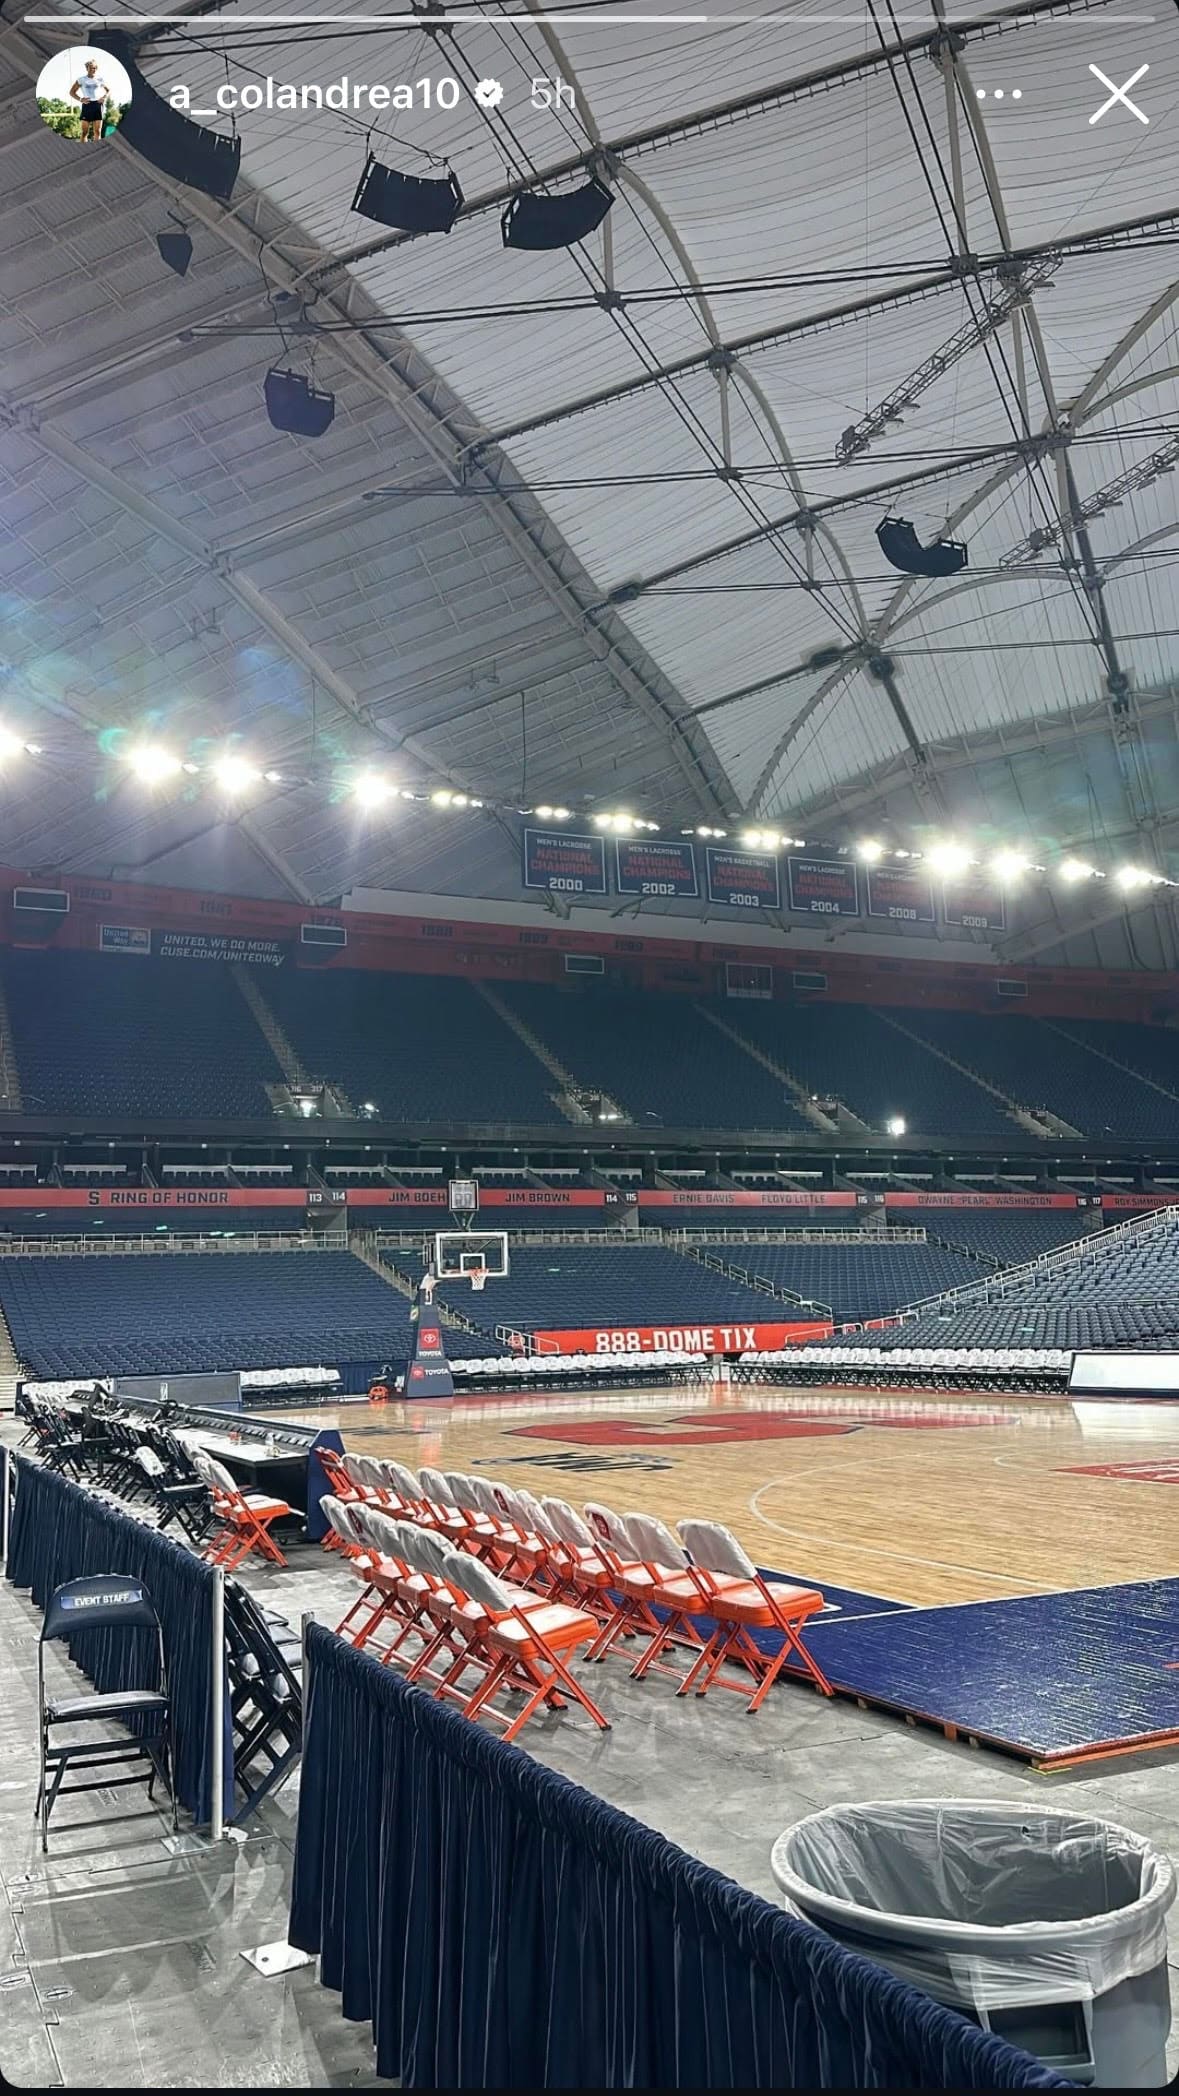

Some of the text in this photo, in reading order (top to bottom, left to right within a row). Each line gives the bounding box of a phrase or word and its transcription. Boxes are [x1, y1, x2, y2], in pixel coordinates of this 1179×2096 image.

[549, 877, 583, 892] 2000
[642, 883, 676, 895] 2002
[729, 893, 760, 907] 2003
[811, 900, 840, 913] 2004
[962, 915, 988, 928] 2009
[210, 939, 227, 948] WE
[229, 940, 245, 950] DO
[160, 946, 285, 963] CUSE.COM/UNITEDWAY
[110, 1192, 147, 1204] RING
[152, 1192, 171, 1204] OF
[176, 1192, 228, 1204] HONOR
[309, 1193, 322, 1203] 113
[332, 1191, 346, 1201] 114
[388, 1192, 448, 1203] JIM BOEH
[505, 1192, 570, 1203] JIM BROWN
[606, 1194, 618, 1203] 114
[626, 1193, 637, 1201] 115
[673, 1193, 735, 1204] ERNIE DAVIS
[761, 1194, 826, 1205] FLOYD LITTLE
[917, 1195, 954, 1206] DWAYNE
[995, 1196, 1052, 1206] WASHINGTON
[595, 1327, 757, 1352] 888-DOME TIX
[424, 1368, 450, 1376] TOYOTA
[74, 1593, 130, 1607] EVENT STAFF
